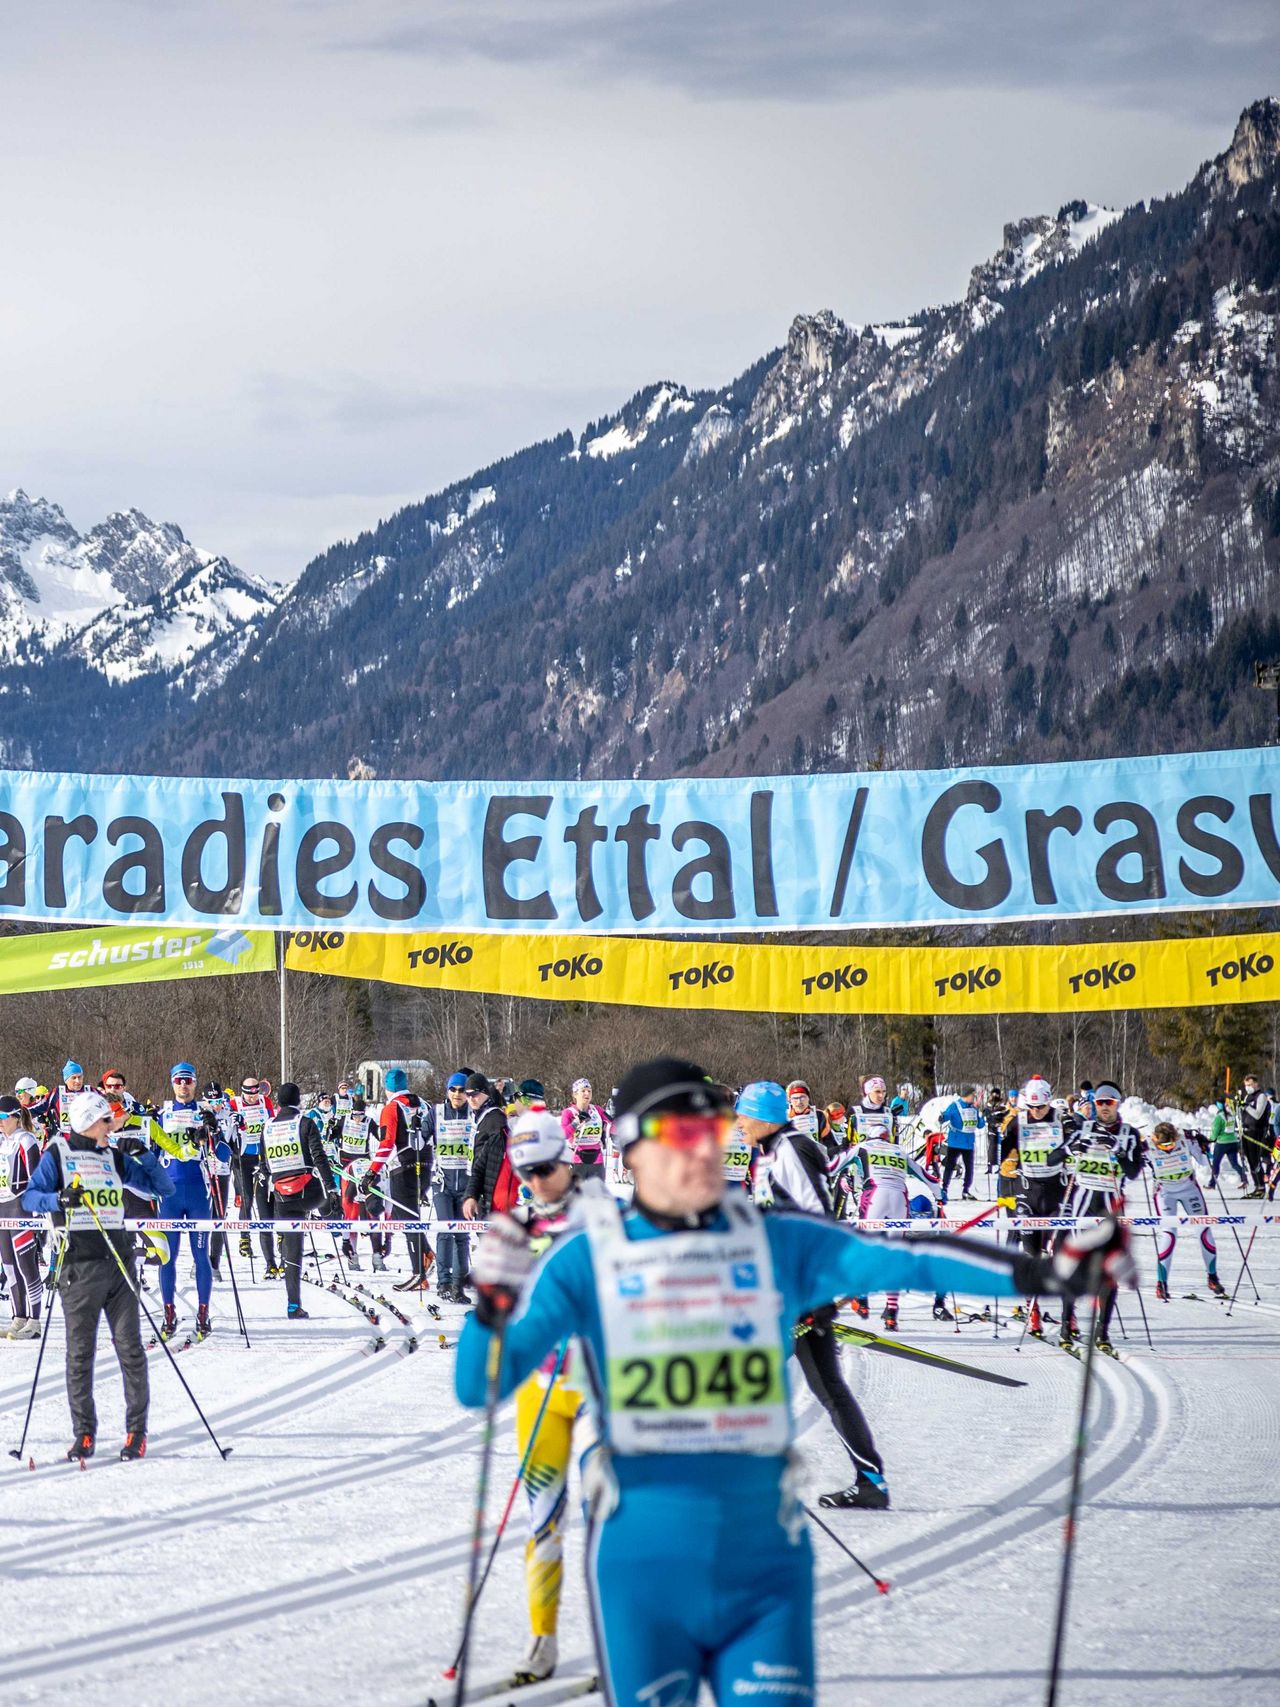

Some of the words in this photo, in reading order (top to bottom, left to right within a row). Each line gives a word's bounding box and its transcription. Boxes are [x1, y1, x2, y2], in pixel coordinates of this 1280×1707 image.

[482, 790, 780, 922] Ettal
[830, 787, 869, 917] /
[48, 934, 201, 971] schuster
[408, 940, 473, 969] TOKO
[182, 960, 205, 970] 1913
[538, 953, 603, 982] TOKO
[1206, 951, 1275, 988] TOKO
[668, 961, 735, 991] TOKO
[802, 965, 868, 996] TOKO
[935, 965, 1002, 997] TOKO
[1069, 961, 1136, 994] TOKO
[344, 1135, 365, 1146] 2077
[268, 1143, 299, 1159] 2099
[871, 1155, 906, 1169] 2155
[82, 1189, 119, 1207] 060
[146, 1221, 198, 1229] INTERSPORT
[223, 1222, 274, 1230] INTERSPORT
[301, 1222, 352, 1230] INTERSPORT
[379, 1222, 431, 1230] INTERSPORT
[858, 1221, 912, 1229] INTERSPORT
[1023, 1219, 1078, 1228] INTERSPORT
[1190, 1216, 1246, 1225] INTERSPORT
[622, 1350, 773, 1409] 2049
